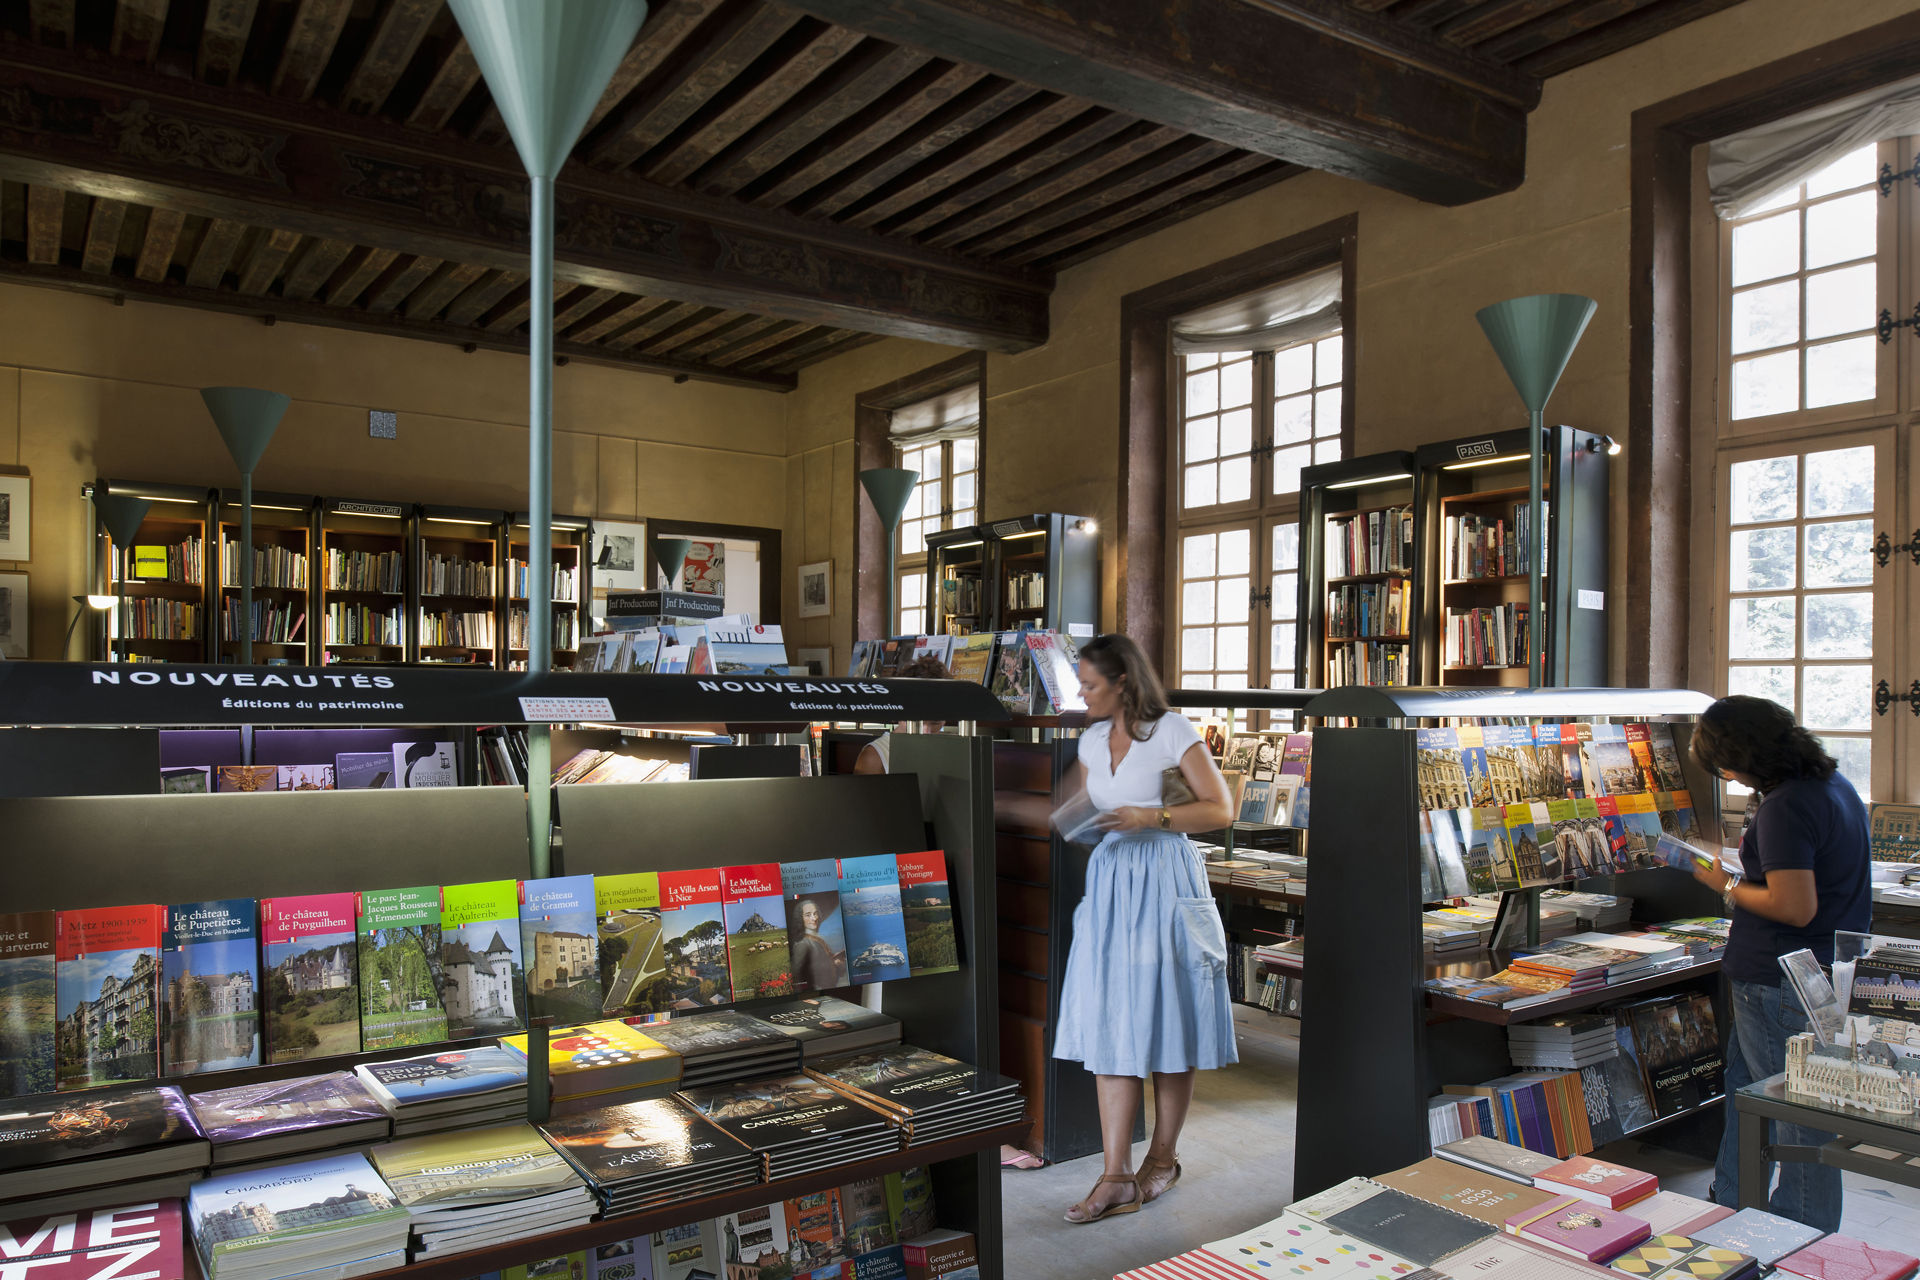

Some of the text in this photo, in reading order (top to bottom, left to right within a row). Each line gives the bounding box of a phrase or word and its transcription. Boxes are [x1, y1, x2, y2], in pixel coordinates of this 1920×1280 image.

[1460, 444, 1492, 456] PARIS
[341, 504, 400, 514] ARCHITECTURE
[608, 598, 658, 610] Jnf Productions
[666, 598, 720, 612] Jnf Productions
[1582, 593, 1600, 606] PARIS
[715, 626, 752, 643] vmf
[960, 666, 980, 674] Grand
[92, 669, 395, 690] NOUVEAUTÉS
[697, 679, 890, 696] NOUVEAUTÉS
[222, 696, 404, 712] Éditions du patrimoine
[790, 700, 904, 713] Éditions du patrimoine
[1232, 755, 1248, 765] Paris
[341, 764, 364, 774] Mobilier
[1244, 788, 1268, 802] ART
[781, 866, 808, 874] Voltaire
[856, 870, 882, 878] château
[884, 867, 895, 875] d'If
[897, 864, 924, 872] L'abbaye
[805, 871, 831, 880] château
[906, 870, 934, 881] Pontigny
[730, 884, 771, 894] Saint-Michel
[793, 880, 815, 891] Ferney
[380, 895, 397, 904] parc
[399, 892, 419, 902] Jean-
[529, 892, 573, 902] Le château
[612, 887, 647, 898] mégalithes
[449, 901, 496, 912] Le château
[530, 901, 579, 912] de Gramont
[609, 895, 655, 906] Locmariaquer
[367, 901, 437, 915] Jacques Rousseau
[174, 912, 187, 922] Le
[189, 909, 229, 919] château
[279, 909, 329, 921] Le château
[375, 911, 428, 922] Ermenonville
[449, 910, 498, 922] d'Aulteribe
[69, 922, 97, 932] Metz
[101, 918, 147, 929] 1900-1939
[174, 917, 241, 931] de Pupetières
[279, 918, 347, 931] de Puyguilhem
[18, 931, 29, 939] et
[107, 930, 132, 938] impérial
[174, 930, 214, 940] Viollet-le-Duc
[222, 926, 250, 936] Dauphiné
[6, 941, 49, 953] arverne
[376, 1064, 435, 1076] Palais
[381, 1069, 448, 1082] Grand
[1582, 1065, 1597, 1079] 100
[1582, 1075, 1604, 1090] MONU
[1584, 1084, 1609, 1102] MENTS
[1586, 1099, 1610, 1115] POUR
[1590, 1108, 1611, 1126] 2014
[421, 1153, 534, 1175] [monumental]
[225, 1177, 313, 1195] CHAMBORD
[854, 1183, 879, 1193] Monuments
[1455, 1187, 1475, 1199] 2014
[1461, 1189, 1493, 1205] GOOD
[1478, 1195, 1504, 1208] FEEL
[798, 1206, 828, 1218] Monuments
[856, 1205, 882, 1218] Promenades
[738, 1221, 772, 1234] Monuments
[801, 1225, 832, 1238] Promenades
[667, 1238, 702, 1250] Monuments
[741, 1243, 773, 1256] Promenades
[33, 1246, 104, 1260] MÉTAMORPHOSES
[930, 1252, 958, 1265] Gergovie
[597, 1256, 634, 1269] Monuments
[670, 1259, 705, 1273] Promenades
[866, 1256, 890, 1268] château
[938, 1262, 952, 1272] pays
[953, 1256, 976, 1266] arverne
[1474, 1256, 1504, 1270] 2014
[866, 1262, 898, 1276] Pupetières
